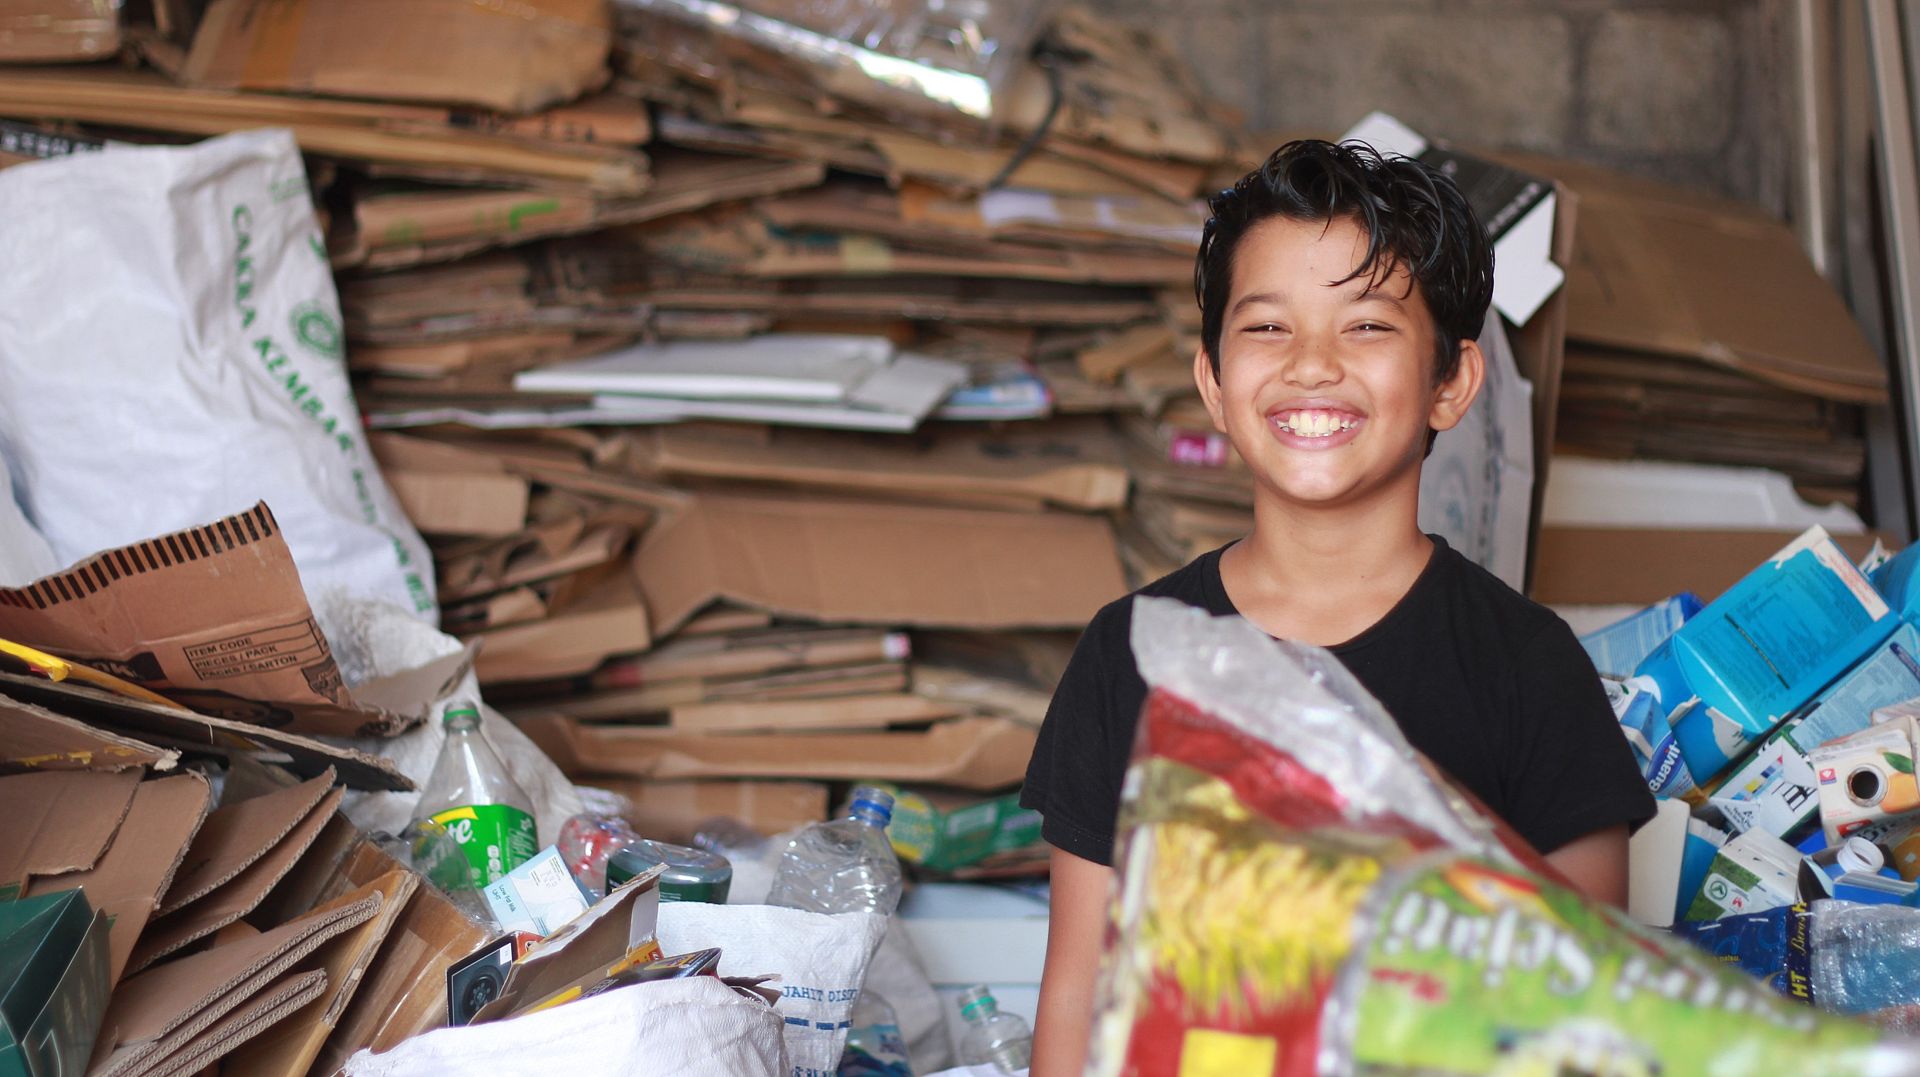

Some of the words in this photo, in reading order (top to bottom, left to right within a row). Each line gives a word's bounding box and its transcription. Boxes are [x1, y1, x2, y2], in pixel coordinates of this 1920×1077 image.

[189, 645, 217, 657] ITEM
[219, 637, 253, 651] CODE
[195, 654, 237, 668] PIECES
[245, 645, 278, 659] PACK
[202, 666, 241, 678] PACKS
[248, 655, 298, 671] CARTON
[1648, 740, 1681, 792] Buavit
[783, 986, 823, 1003] JAHIT
